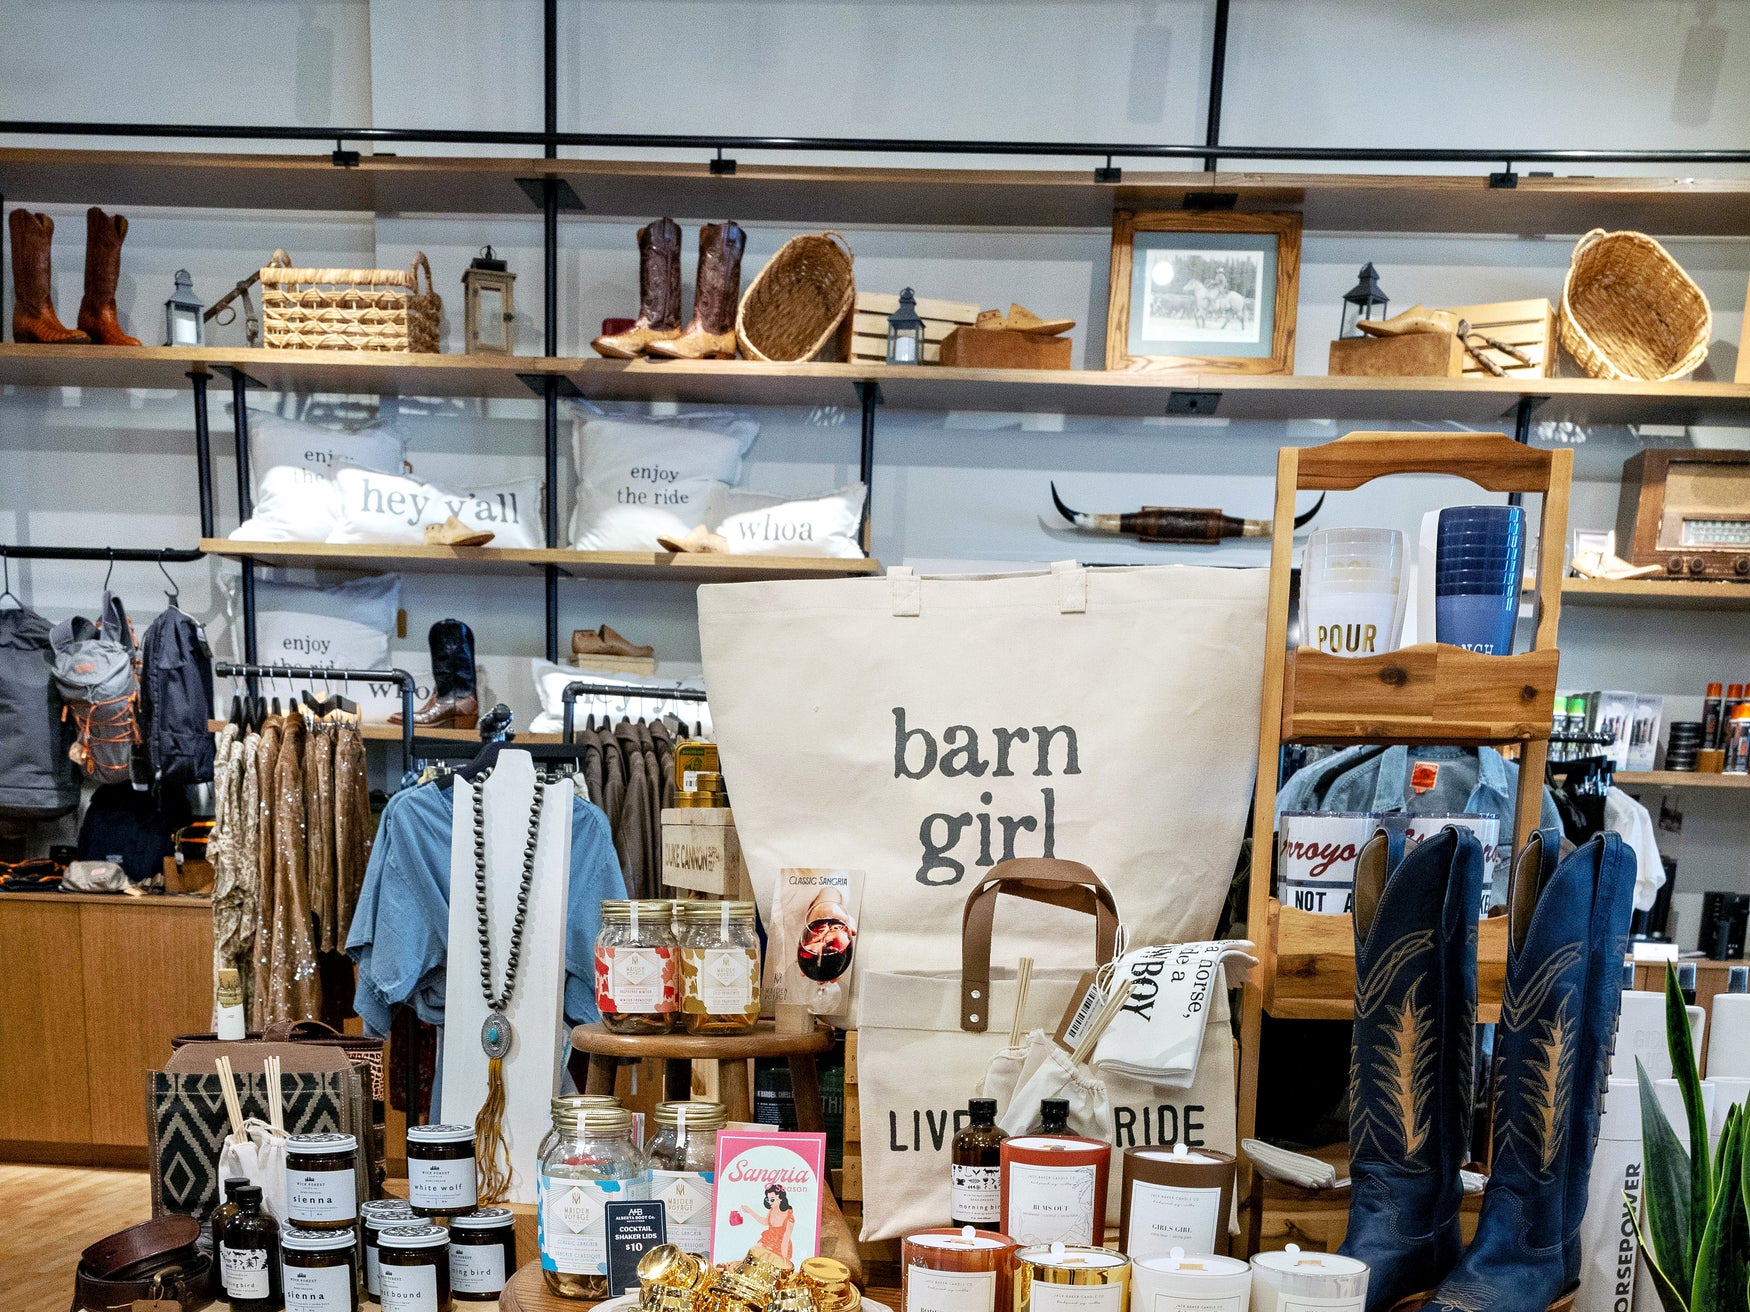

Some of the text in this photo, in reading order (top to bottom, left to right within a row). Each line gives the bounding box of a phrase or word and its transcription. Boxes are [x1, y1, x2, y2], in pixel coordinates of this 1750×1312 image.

[631, 465, 679, 482] enjoy
[361, 478, 429, 526] hey
[617, 486, 689, 504] the ride
[739, 513, 812, 541] whoa
[283, 635, 331, 655] enjoy
[1318, 624, 1377, 653] POUR
[892, 707, 1081, 780] barn
[916, 789, 1055, 886] girl
[789, 876, 848, 886] CLASSIC SANGRIA
[1295, 891, 1327, 912] NOT
[1171, 971, 1185, 983] a
[1115, 1105, 1206, 1148] RIDE
[728, 1160, 809, 1189] Sangria
[776, 1184, 808, 1192] Season
[293, 1195, 333, 1203] sienna
[959, 1204, 988, 1212] morning
[625, 1242, 643, 1251] $10
[287, 1291, 324, 1300] sienna
[391, 1291, 421, 1299] bound
